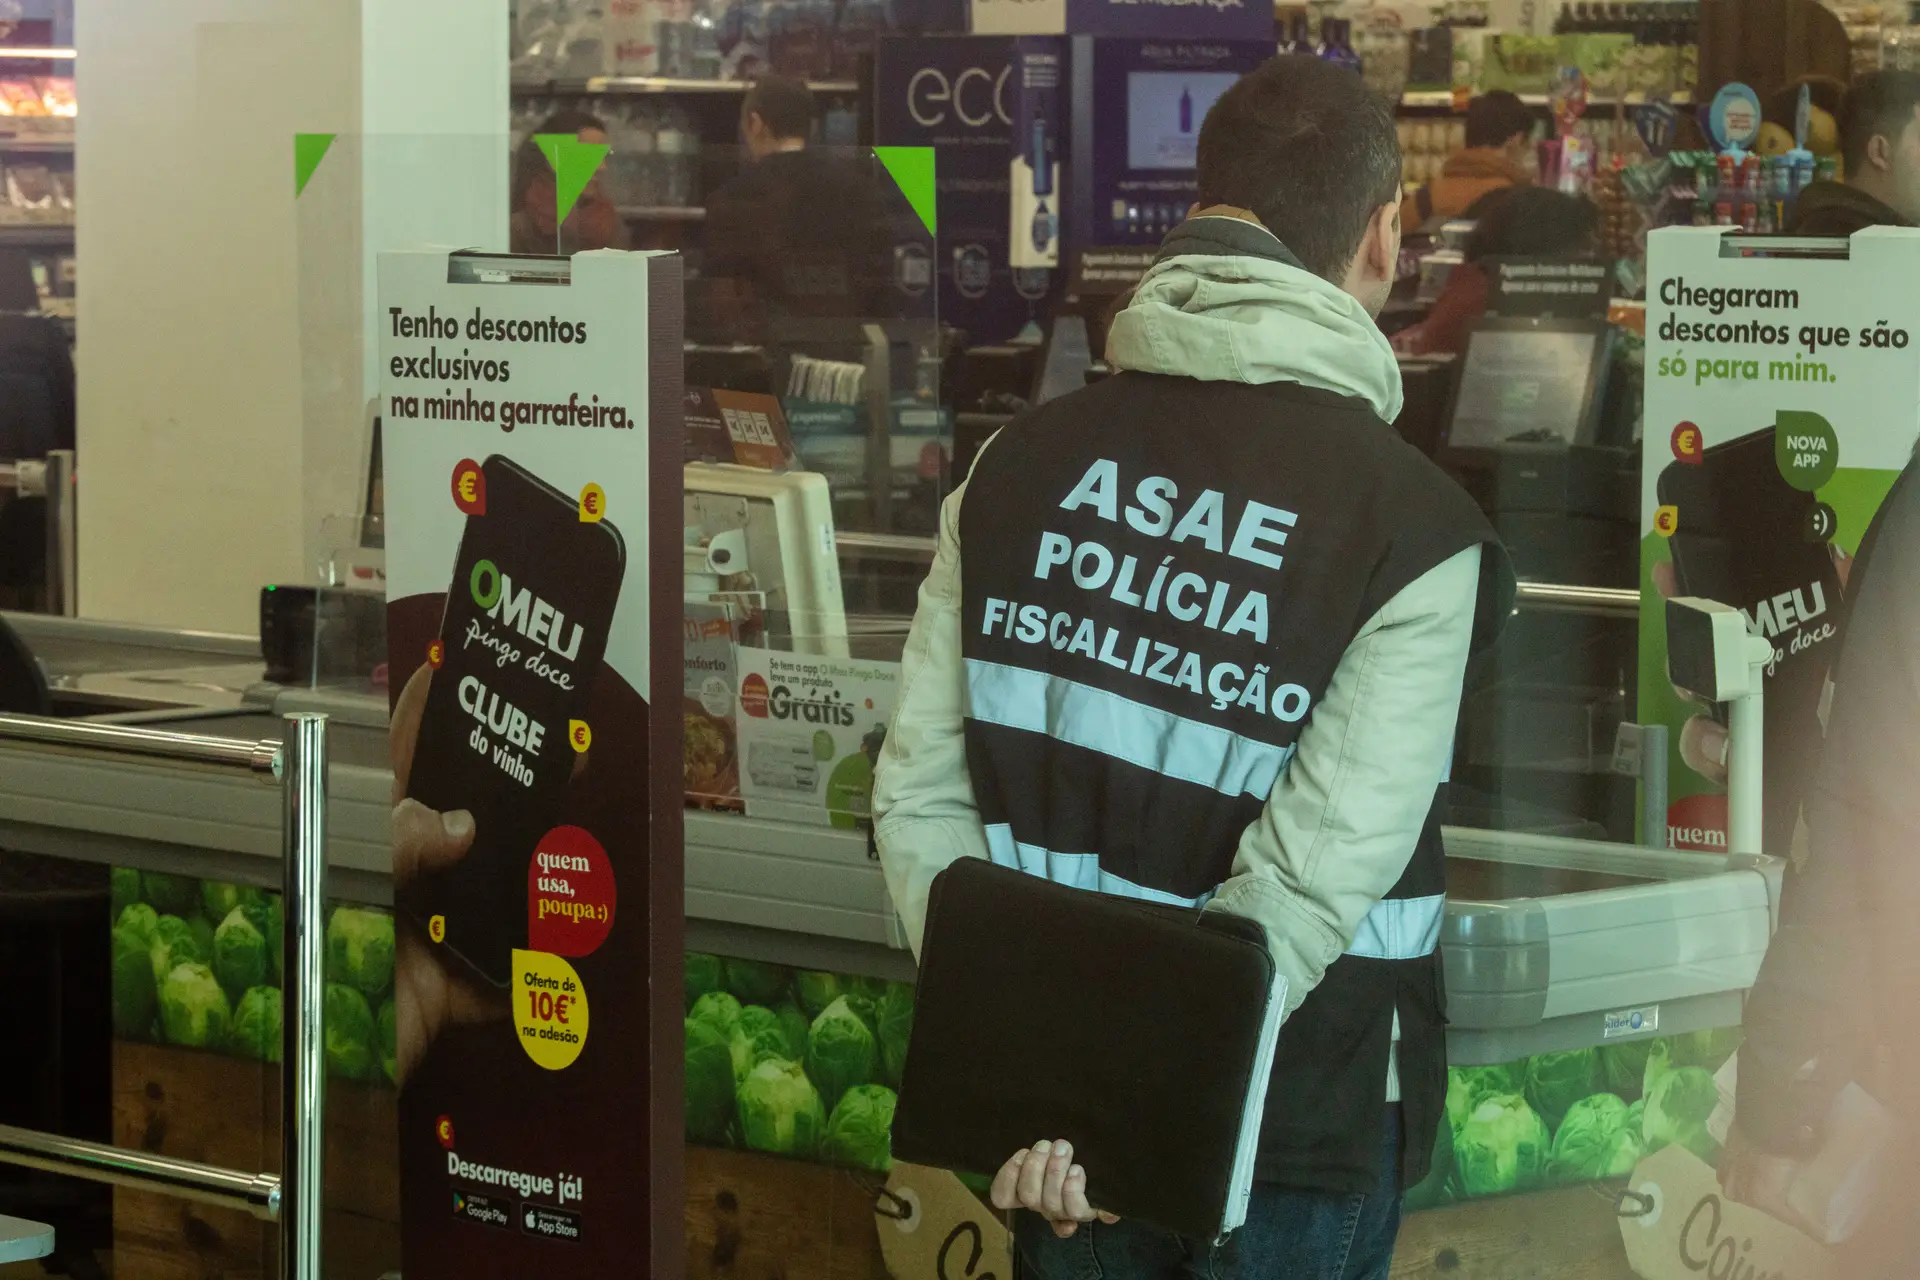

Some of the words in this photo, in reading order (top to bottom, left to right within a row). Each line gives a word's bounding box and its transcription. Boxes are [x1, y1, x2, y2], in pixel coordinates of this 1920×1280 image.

[1659, 276, 1799, 315] Chegaram
[388, 305, 459, 340] Tenho
[466, 306, 588, 344] descontos
[1658, 312, 1790, 345] descontos
[1798, 325, 1850, 354] que
[1859, 319, 1909, 349] são
[390, 346, 510, 382] exclusivos
[1658, 348, 1687, 378] só
[1695, 357, 1759, 386] para
[1768, 352, 1837, 383] mim.
[391, 394, 419, 418] na
[424, 387, 495, 422] minha
[500, 392, 634, 433] garrafeira.
[1786, 434, 1828, 451] NOVA
[1792, 453, 1821, 468] APP
[1059, 458, 1299, 571] ASAE
[1034, 531, 1269, 645] POLÍCIA
[463, 617, 521, 668] pingo
[525, 651, 575, 691] doce
[1790, 619, 1836, 653] doce
[769, 657, 779, 671] Se
[981, 597, 1311, 723] FISCALIZAÇÃO
[769, 670, 786, 683] leve
[787, 675, 800, 685] um
[801, 675, 834, 689] produto
[458, 675, 546, 756] CLUBE
[769, 684, 855, 727] Grátis
[469, 725, 488, 755] do
[493, 744, 534, 787] vinho
[537, 851, 591, 874] quem
[537, 875, 575, 898] usa,
[524, 972, 559, 990] Oferta
[562, 977, 576, 992] de
[522, 1025, 537, 1038] na
[539, 1026, 579, 1044] adesão
[448, 1151, 554, 1197] Descarregue
[558, 1172, 583, 1204] já!
[467, 1203, 492, 1222] Google
[492, 1208, 508, 1226] Play
[537, 1218, 554, 1235] App
[555, 1221, 578, 1238] Store
